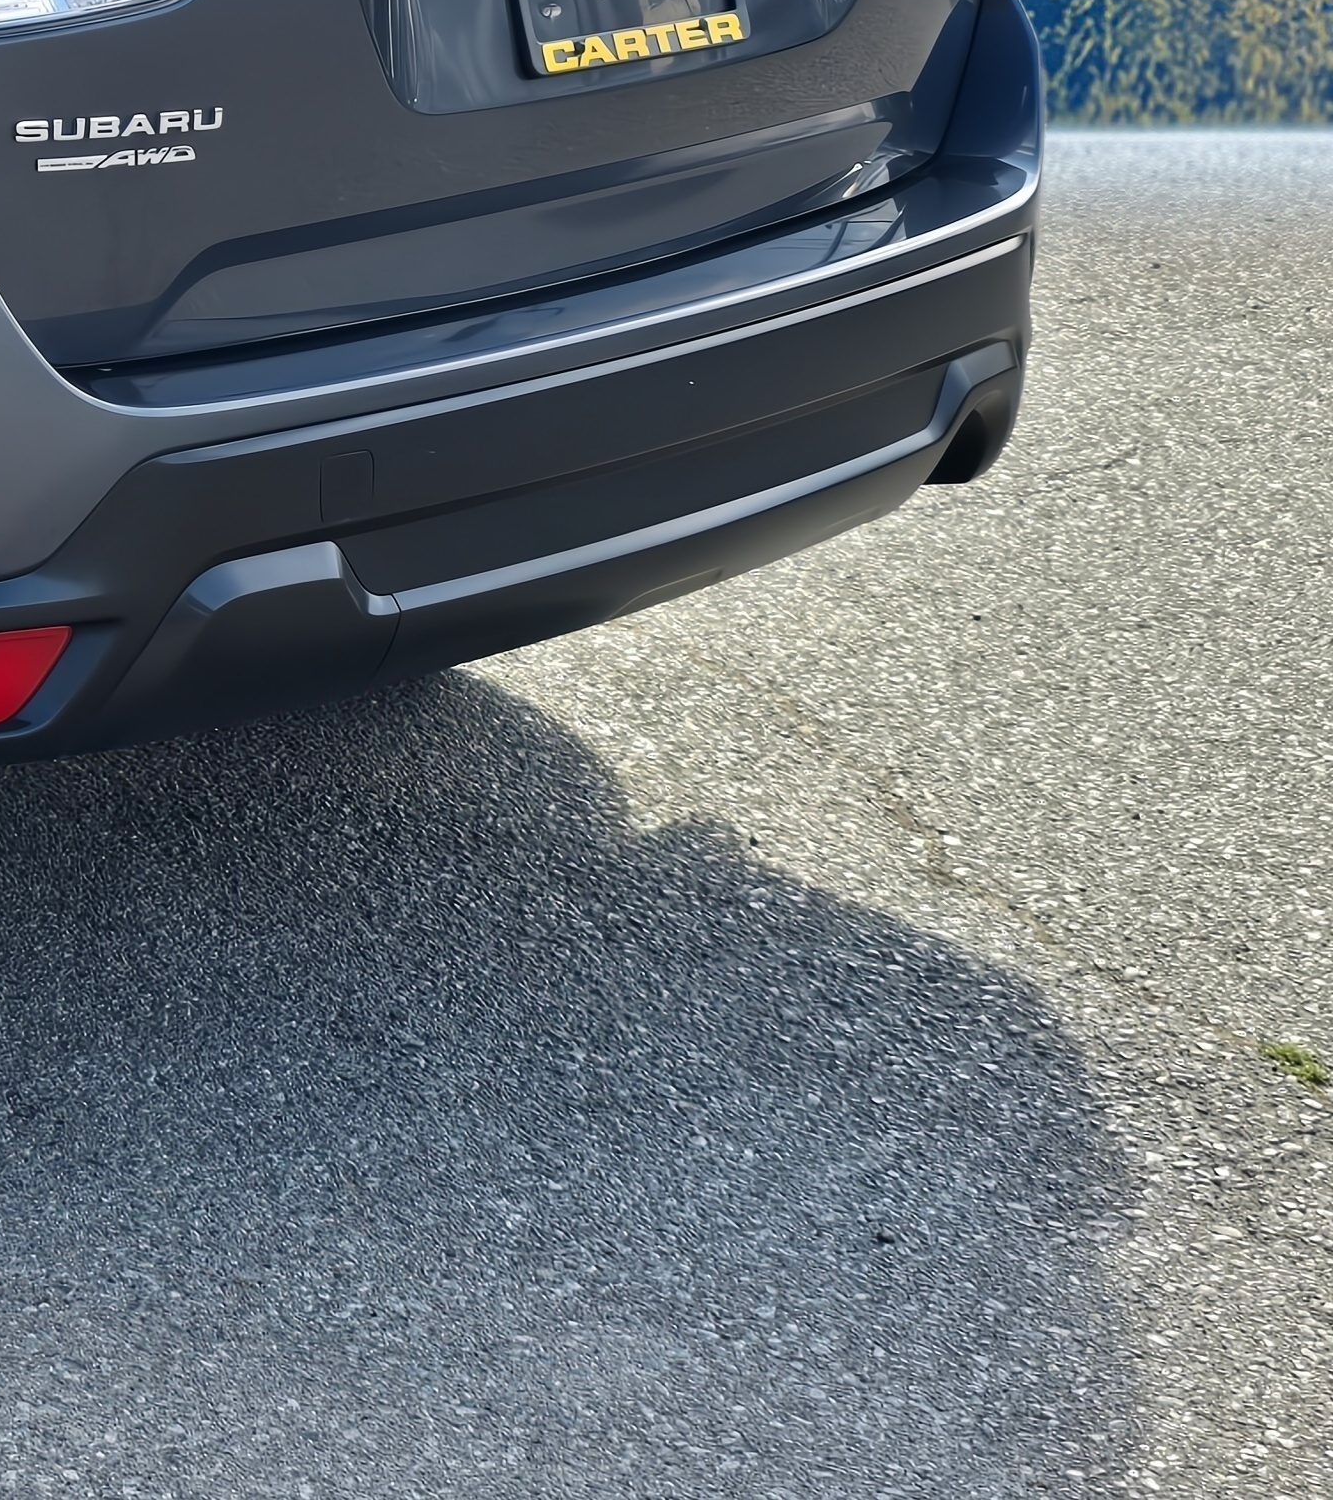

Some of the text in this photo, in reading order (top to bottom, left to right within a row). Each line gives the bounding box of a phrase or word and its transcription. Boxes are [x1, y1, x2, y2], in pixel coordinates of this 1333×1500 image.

[541, 12, 745, 74] CARTER
[14, 106, 225, 143] SUBARU
[96, 145, 197, 169] AWD
